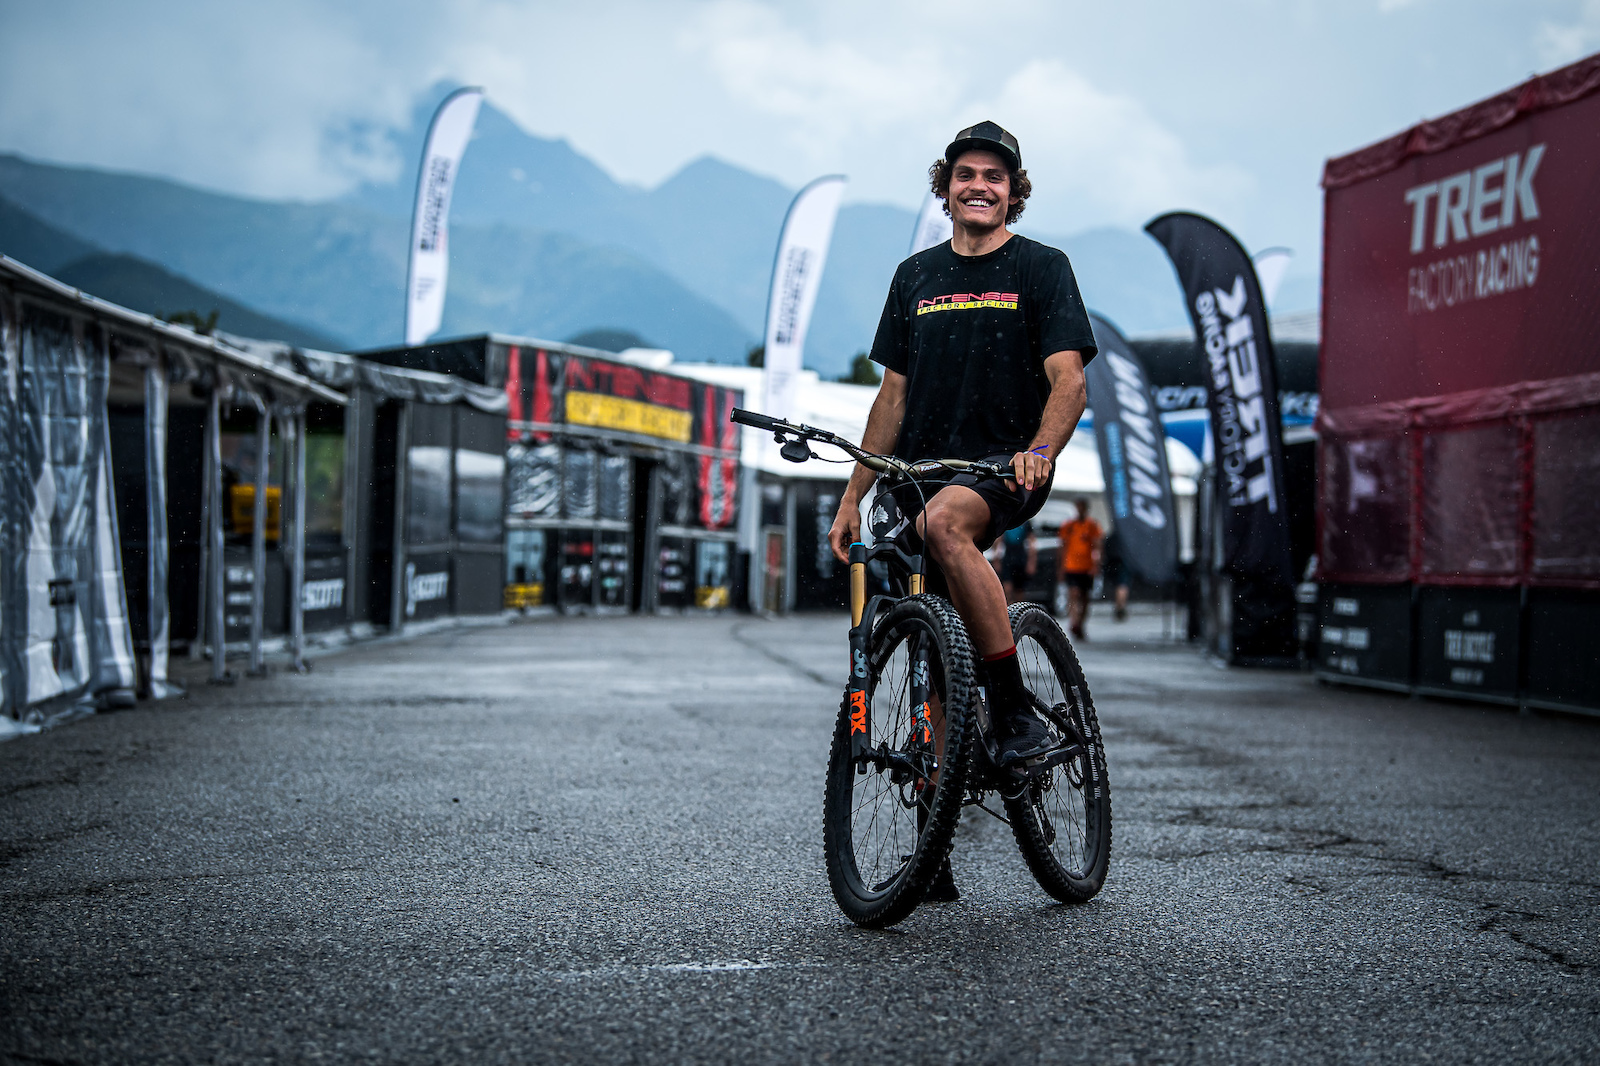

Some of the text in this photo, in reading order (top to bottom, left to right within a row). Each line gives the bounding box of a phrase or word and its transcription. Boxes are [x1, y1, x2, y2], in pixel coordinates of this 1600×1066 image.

[1404, 143, 1547, 254] TREK
[1407, 235, 1540, 313] FACTORY RACING
[918, 291, 1019, 308] INTENSE
[920, 300, 1013, 313] FACTORY RACING
[301, 578, 345, 610] SCOTT
[850, 690, 867, 736] FOX
